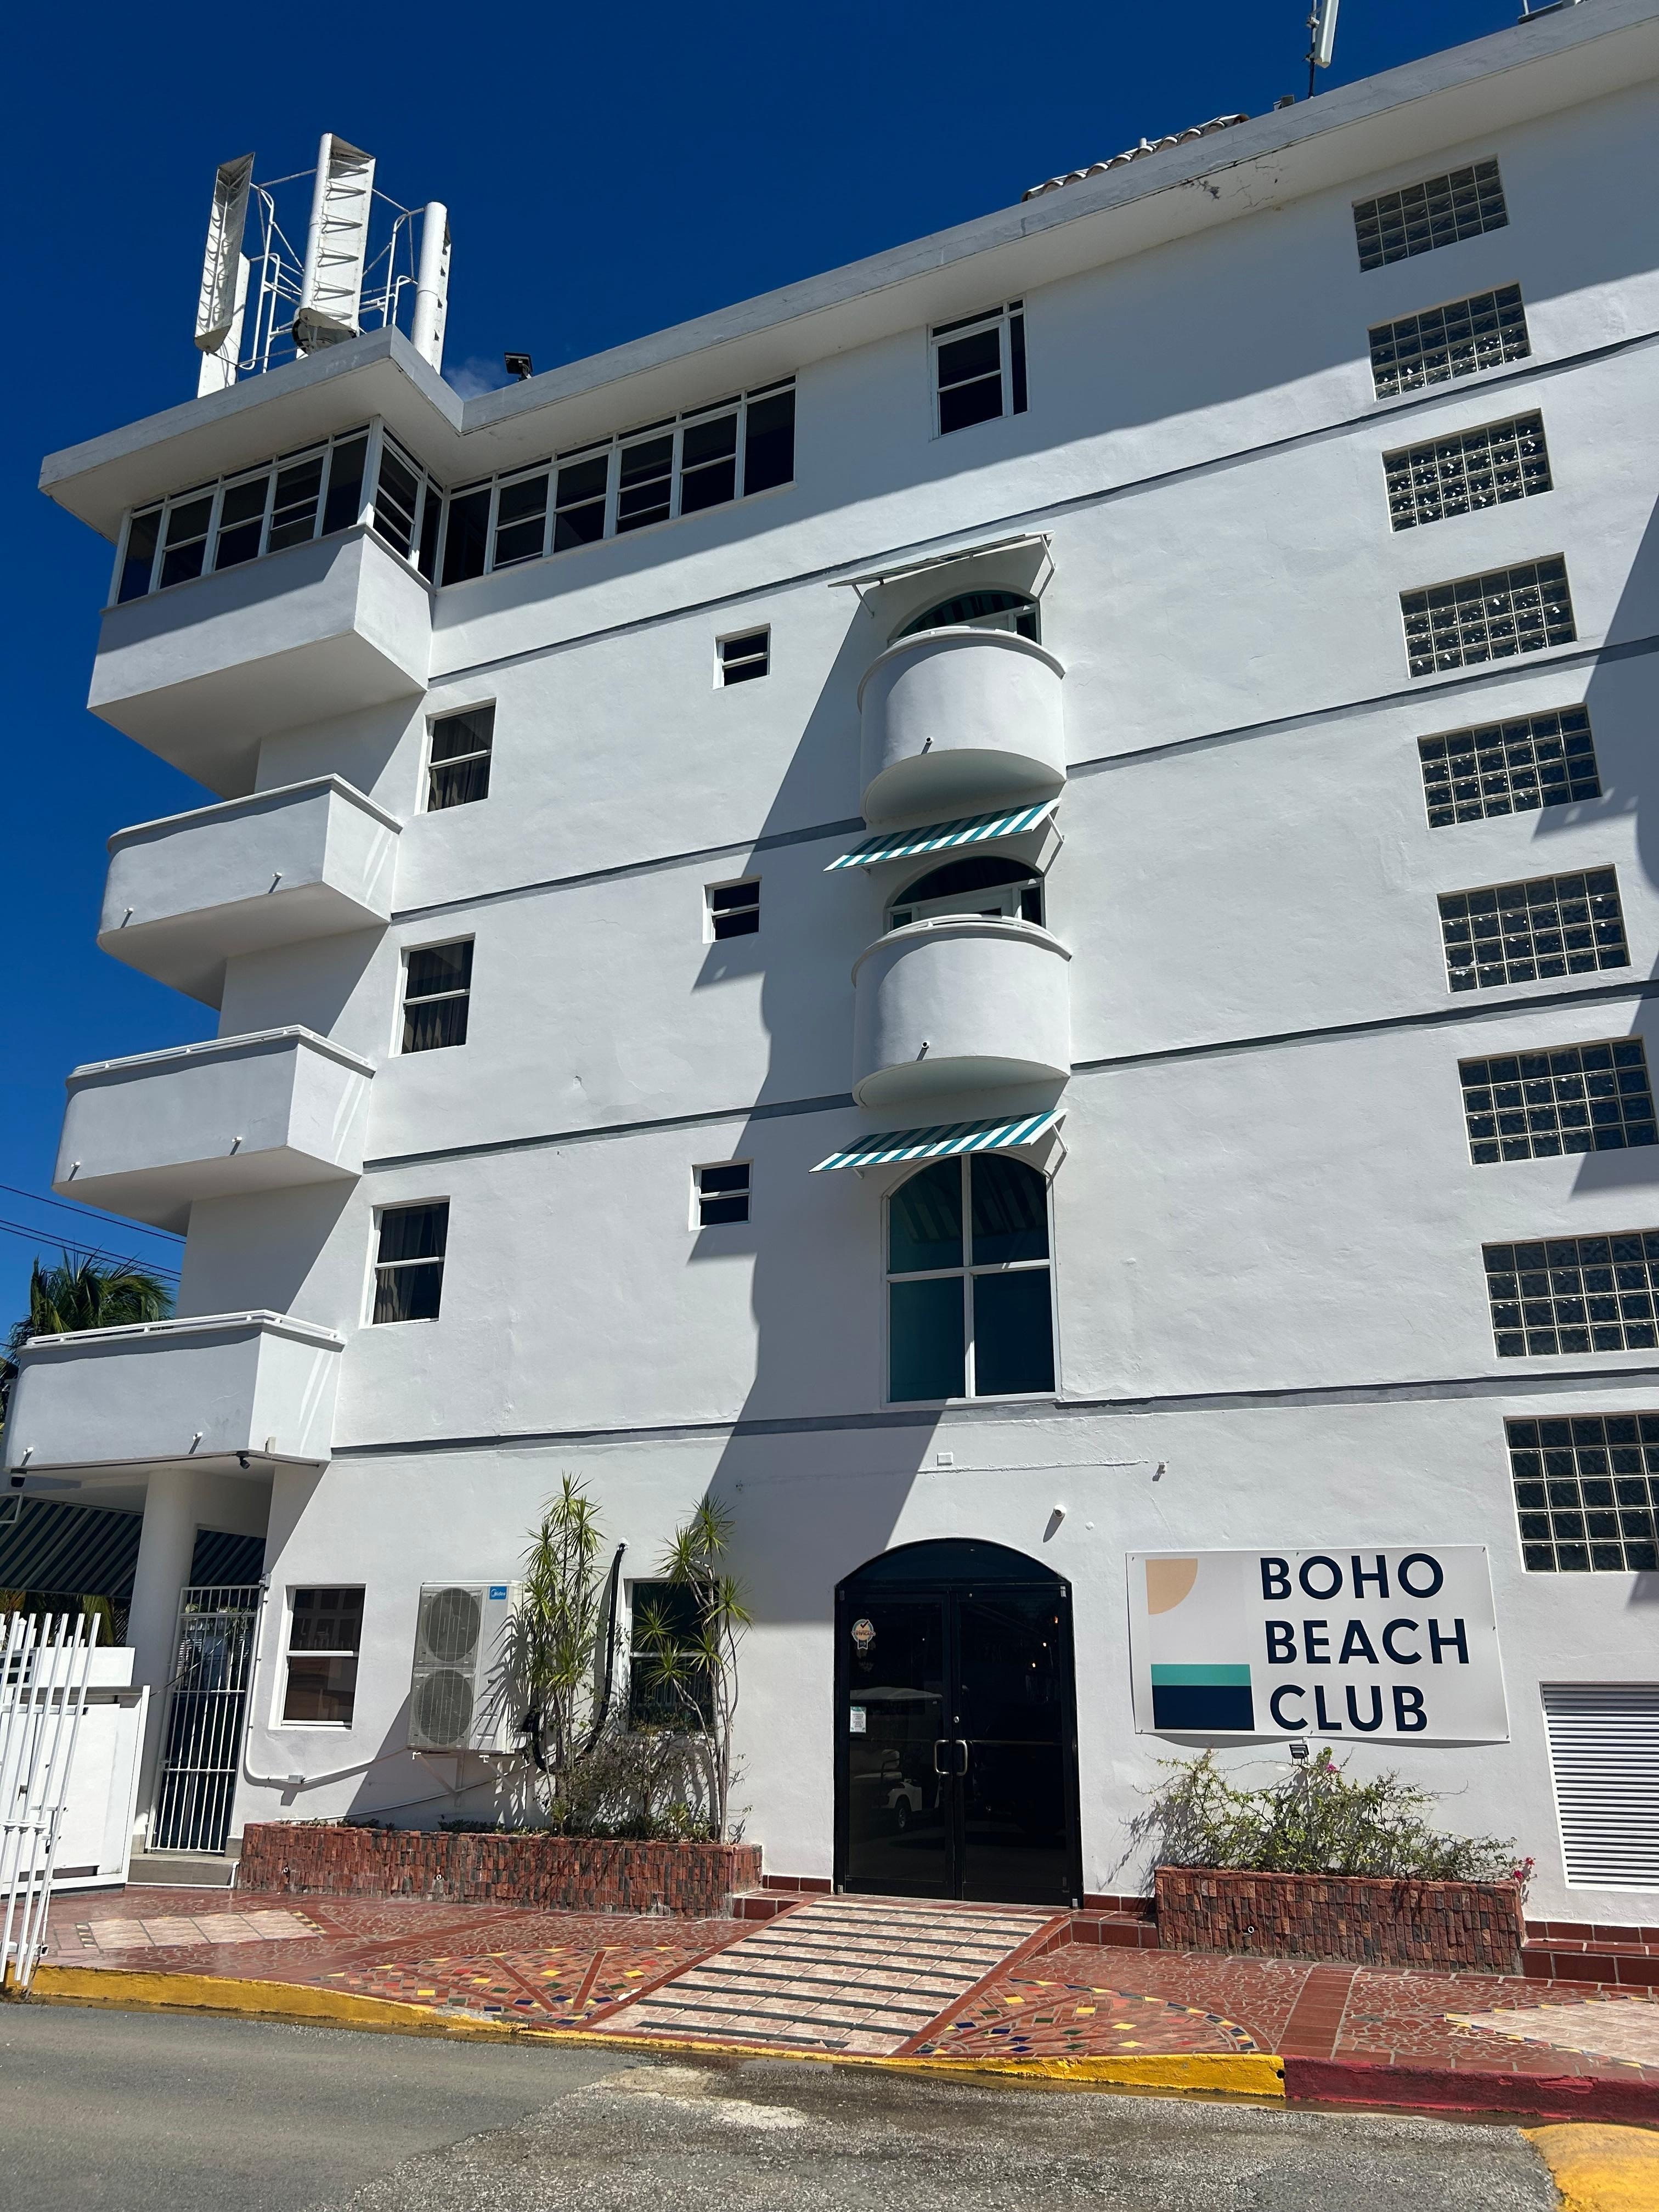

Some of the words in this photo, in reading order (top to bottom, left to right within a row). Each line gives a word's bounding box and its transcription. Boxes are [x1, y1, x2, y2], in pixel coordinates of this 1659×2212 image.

[1260, 1553, 1444, 1600] BOHO
[1265, 1618, 1470, 1665] BEACH
[1269, 1684, 1427, 1731] CLUB
